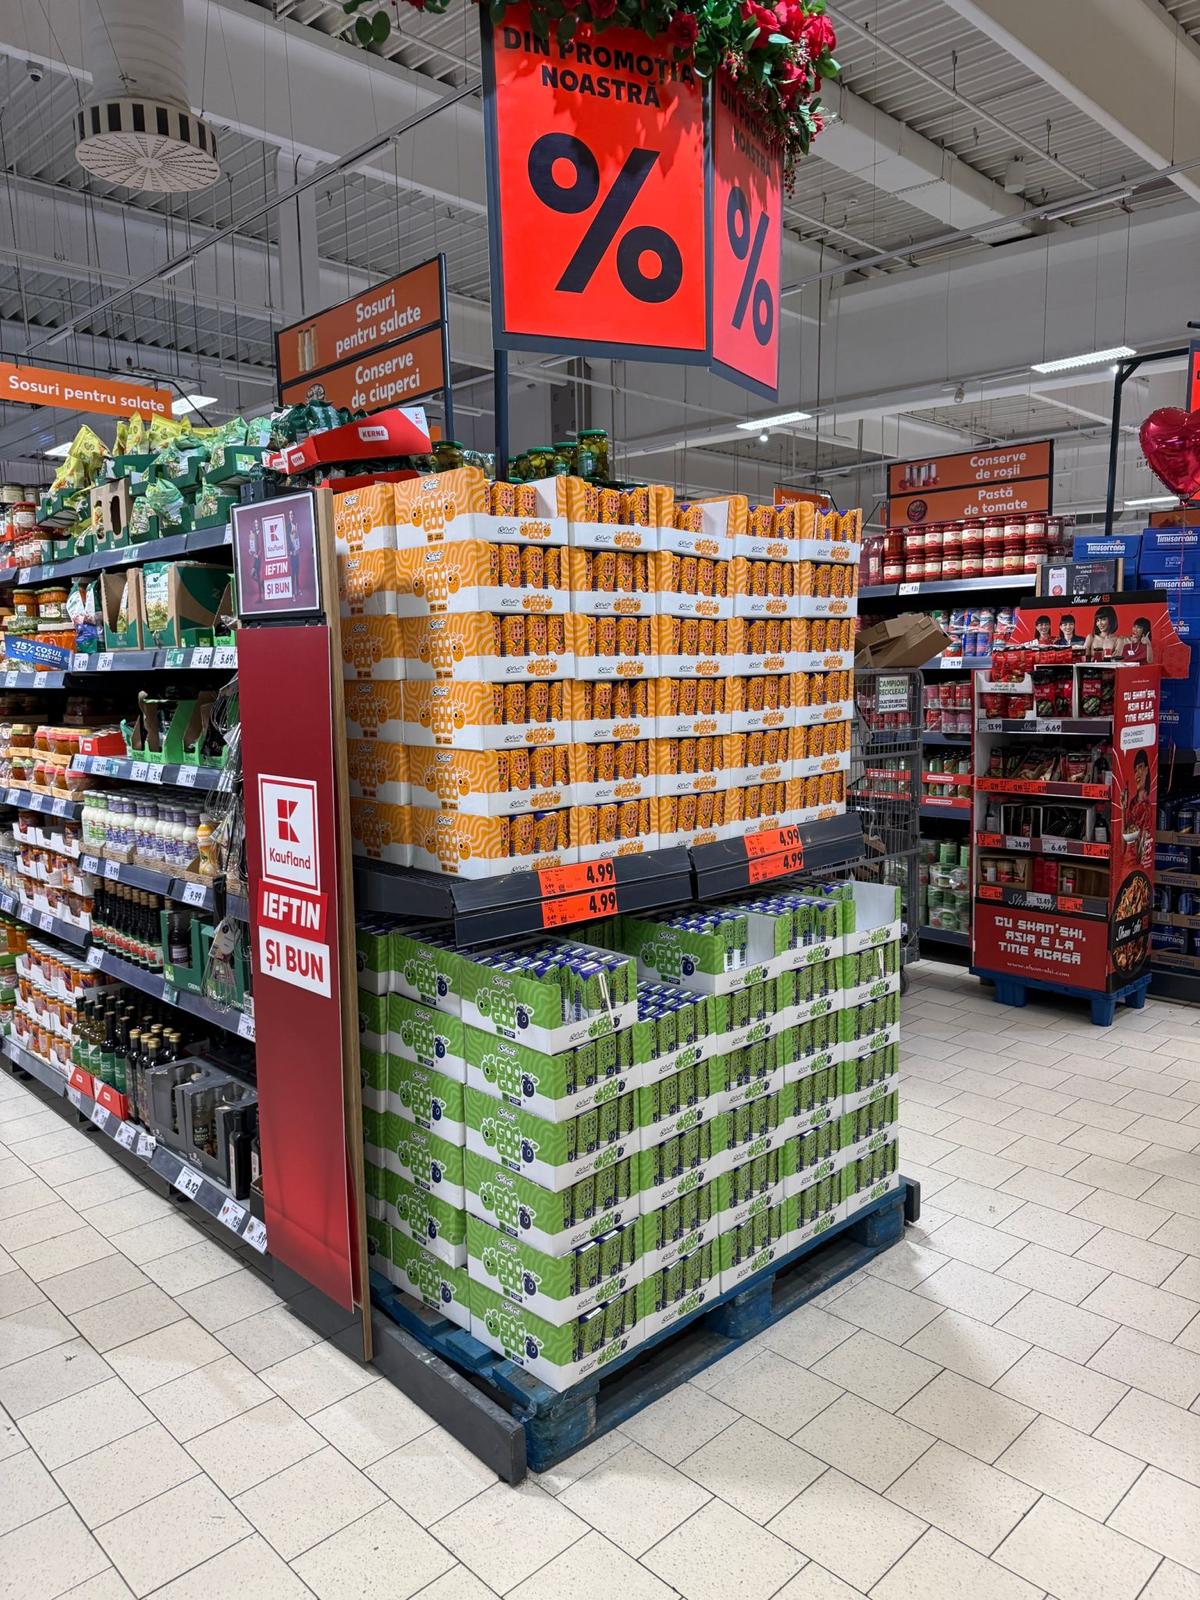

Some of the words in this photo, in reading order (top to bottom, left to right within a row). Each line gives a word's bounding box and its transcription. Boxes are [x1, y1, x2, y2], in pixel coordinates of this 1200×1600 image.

[503, 27, 550, 56] DIN
[541, 64, 661, 108] NOASTRĂ
[356, 288, 395, 323] Sosuri
[336, 324, 377, 358] pentru
[380, 306, 421, 336] salate
[355, 351, 414, 385] Conserve
[9, 375, 59, 396] Sosuri
[64, 387, 116, 405] pentru
[120, 395, 165, 412] salate
[351, 390, 367, 409] de
[369, 368, 421, 402] ciuperci
[970, 452, 1027, 467] Conserve
[975, 469, 991, 480] de
[993, 464, 1021, 479] roșii
[978, 487, 1013, 501] Pastă
[964, 505, 979, 515] de
[982, 500, 1028, 514] tomate
[265, 562, 288, 576] IEFTIN
[275, 582, 290, 594] BUN
[779, 829, 799, 846] 4.99
[269, 847, 311, 870] Kaufland
[784, 852, 802, 869] 4.99
[587, 863, 613, 883] 4.99
[263, 891, 321, 931] IEFTIN
[589, 892, 616, 913] 4.99
[994, 915, 1012, 928] CU
[998, 941, 1029, 956] TINE
[1005, 930, 1035, 944] ASIA
[1040, 936, 1050, 947] E
[1055, 939, 1074, 950] LA
[266, 938, 281, 971] ȘI
[286, 945, 324, 983] BUN
[185, 1179, 199, 1194] 8.12
